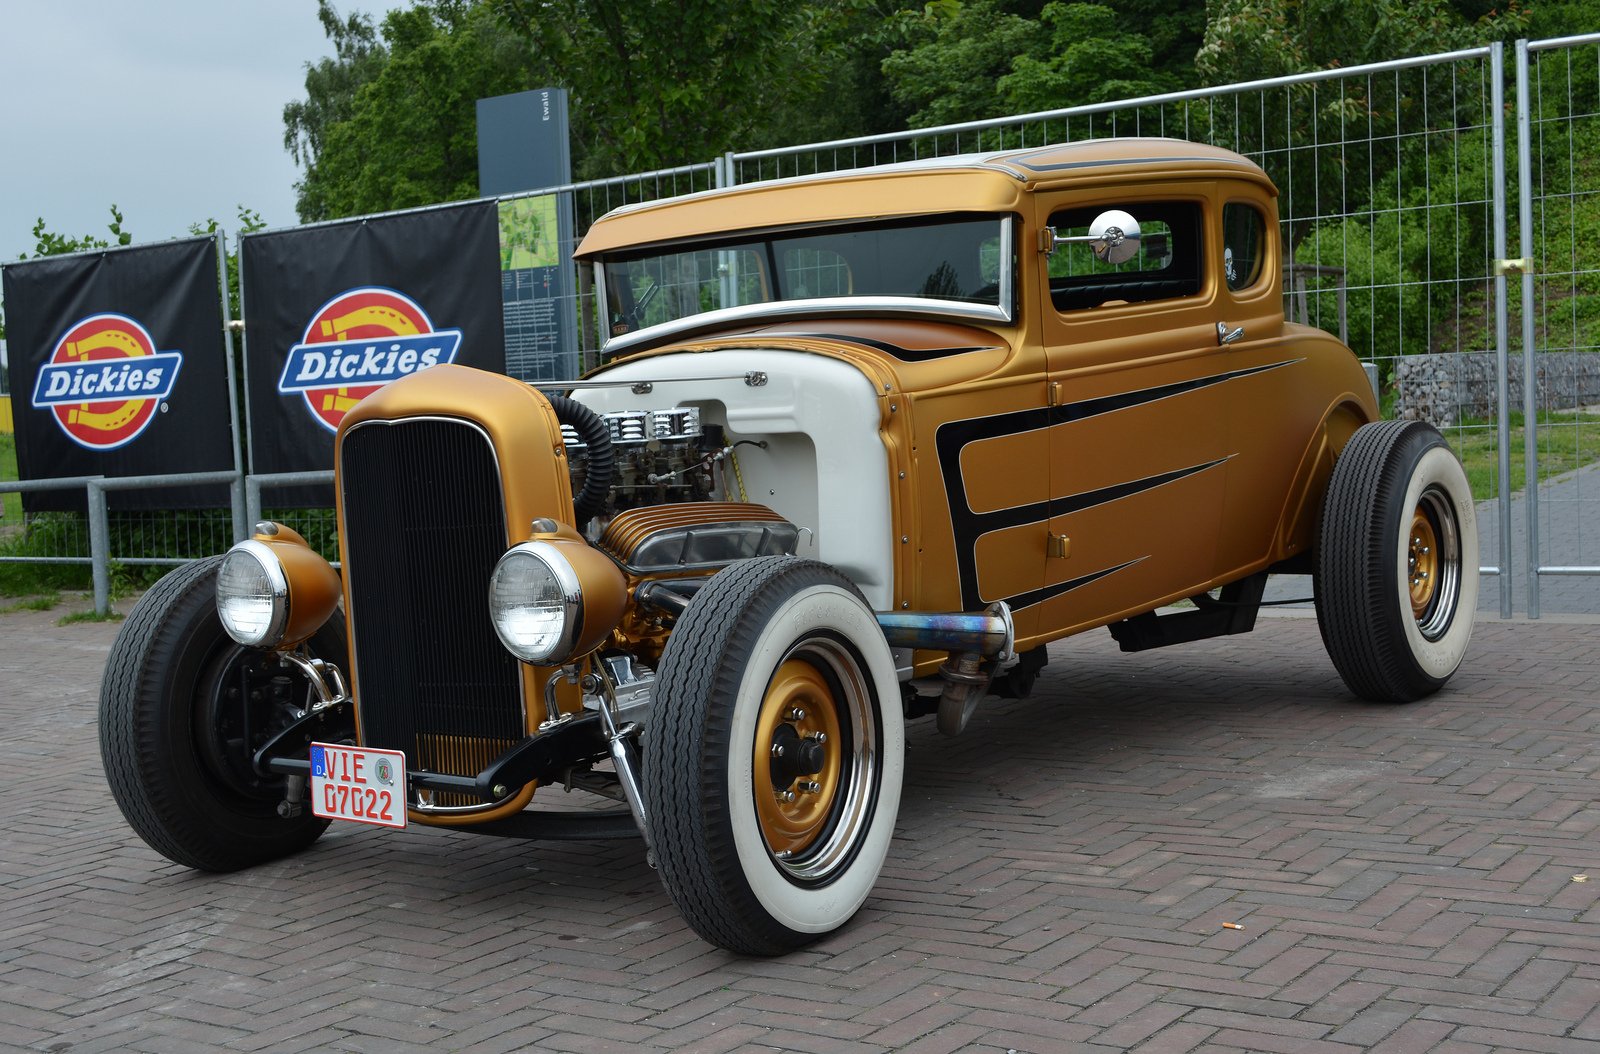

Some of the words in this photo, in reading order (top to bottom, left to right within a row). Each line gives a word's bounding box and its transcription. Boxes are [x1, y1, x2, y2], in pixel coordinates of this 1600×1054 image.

[541, 91, 550, 121] Ewald
[295, 344, 441, 381] Dickies
[44, 364, 164, 397] Dickies
[316, 765, 322, 775] D
[325, 750, 367, 784] VIE
[324, 783, 393, 820] 07022
